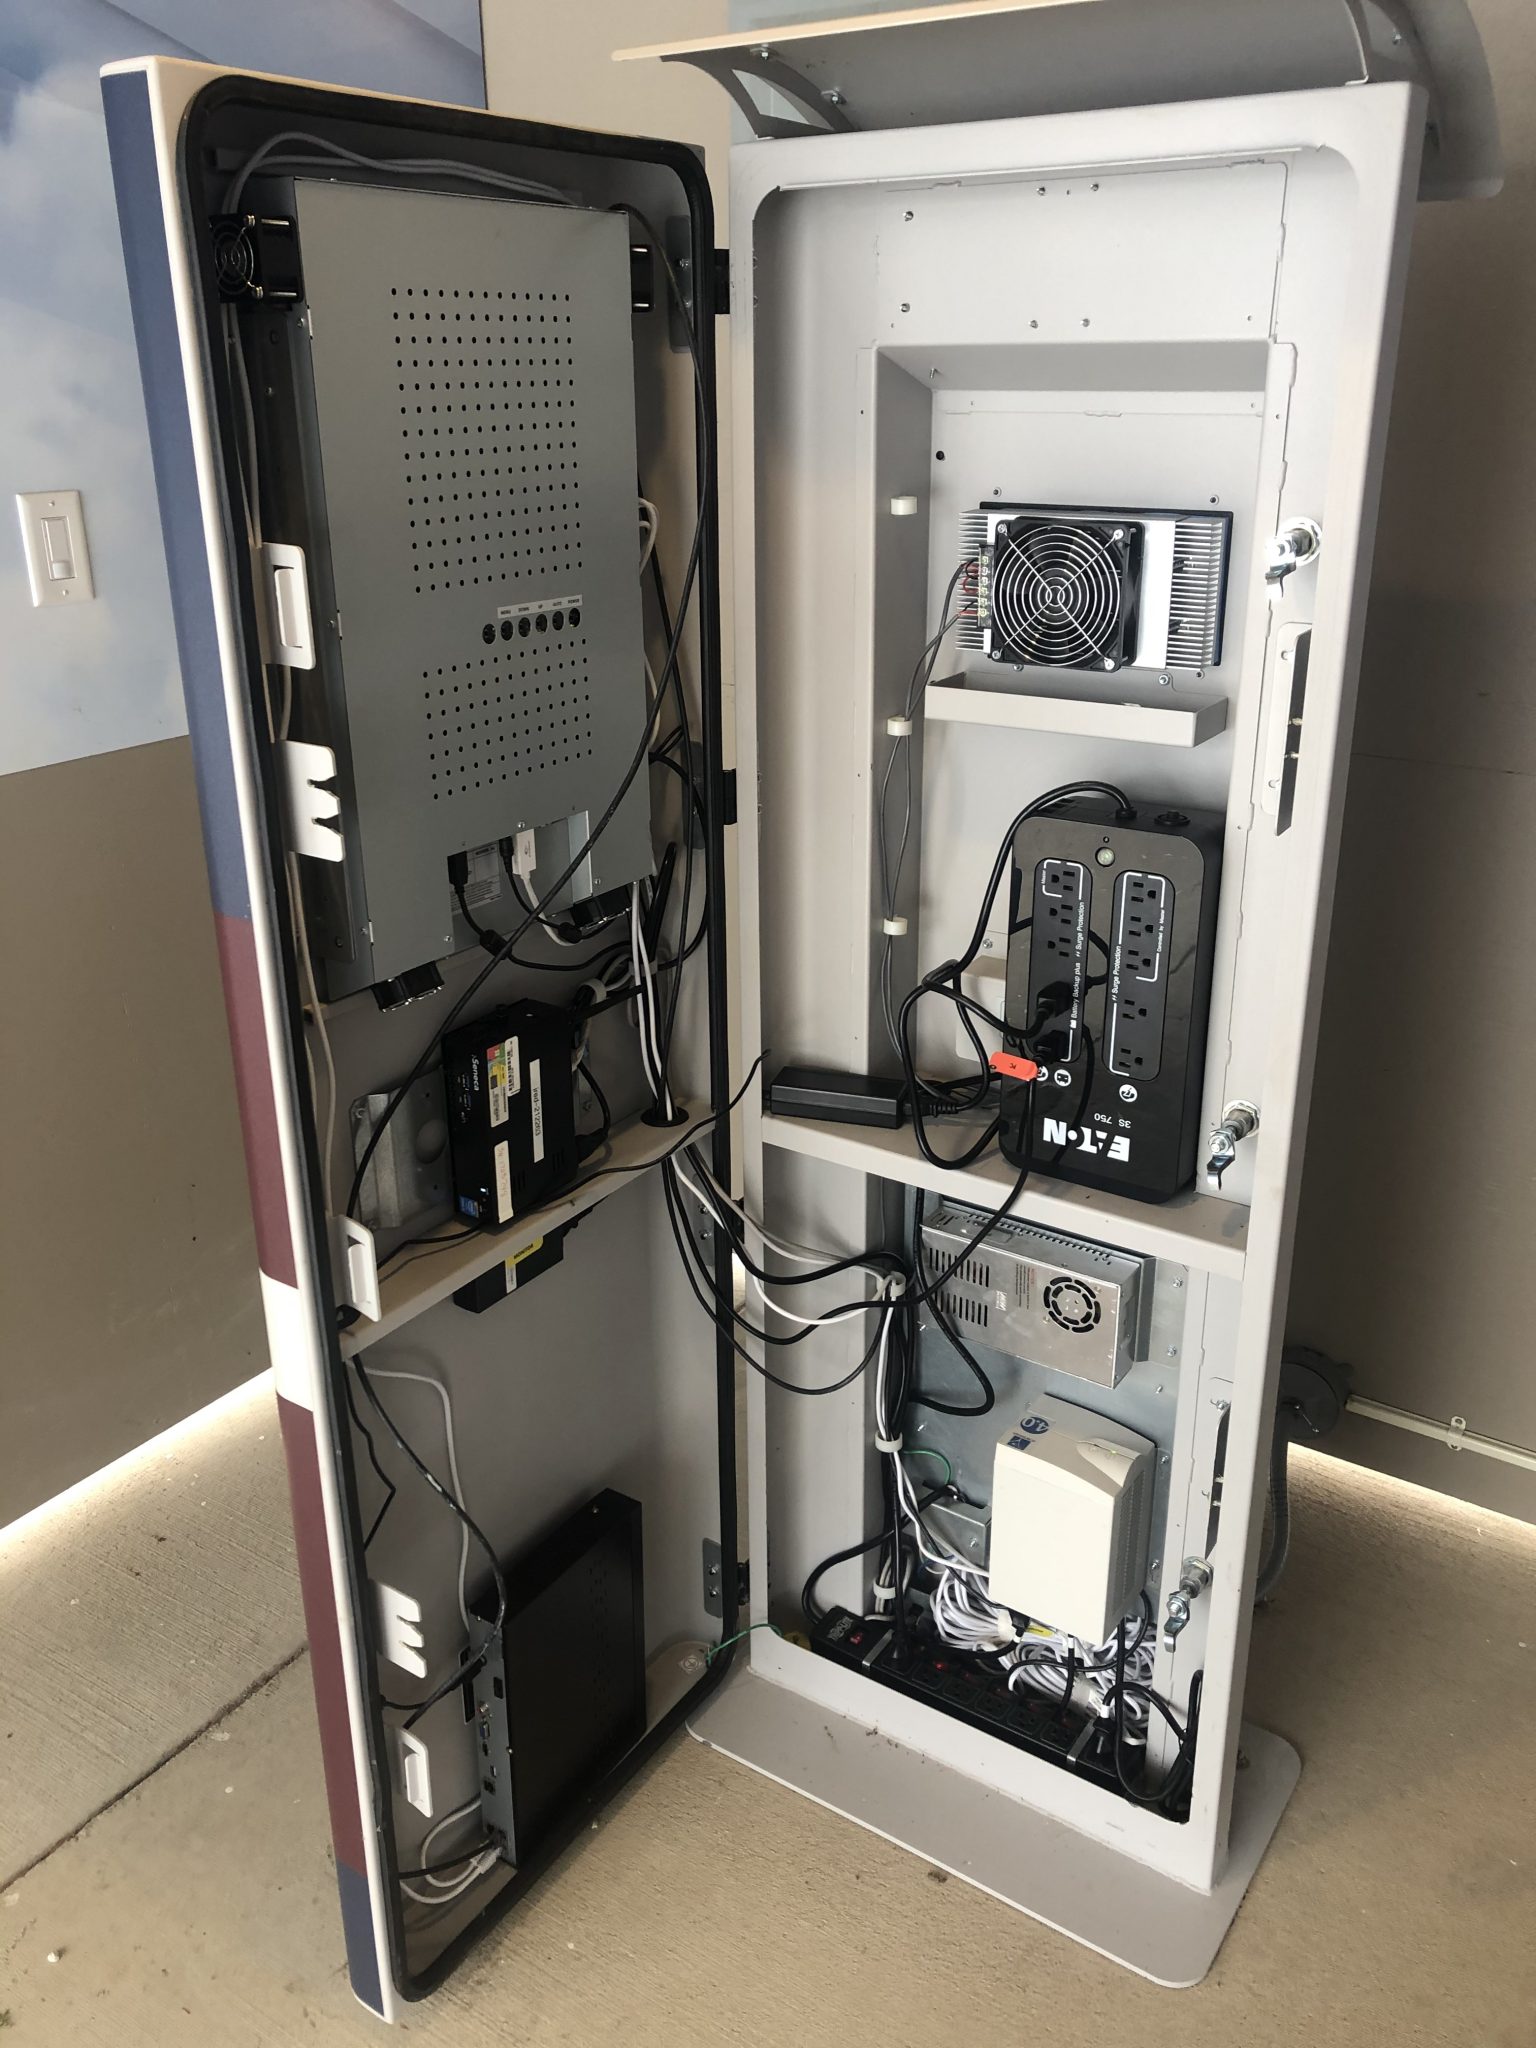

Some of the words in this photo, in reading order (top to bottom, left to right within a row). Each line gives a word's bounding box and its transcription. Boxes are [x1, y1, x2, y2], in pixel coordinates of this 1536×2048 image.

[1076, 901, 1085, 932] Protection
[1075, 931, 1083, 951] Surge
[1112, 945, 1121, 975] Protection
[1072, 975, 1081, 998] Backup
[1111, 975, 1121, 994] Surge
[1070, 997, 1079, 1019] Battery
[1093, 1112, 1113, 1125] 750
[1118, 1118, 1132, 1129] 3S
[1021, 1417, 1049, 1432] 4.0
